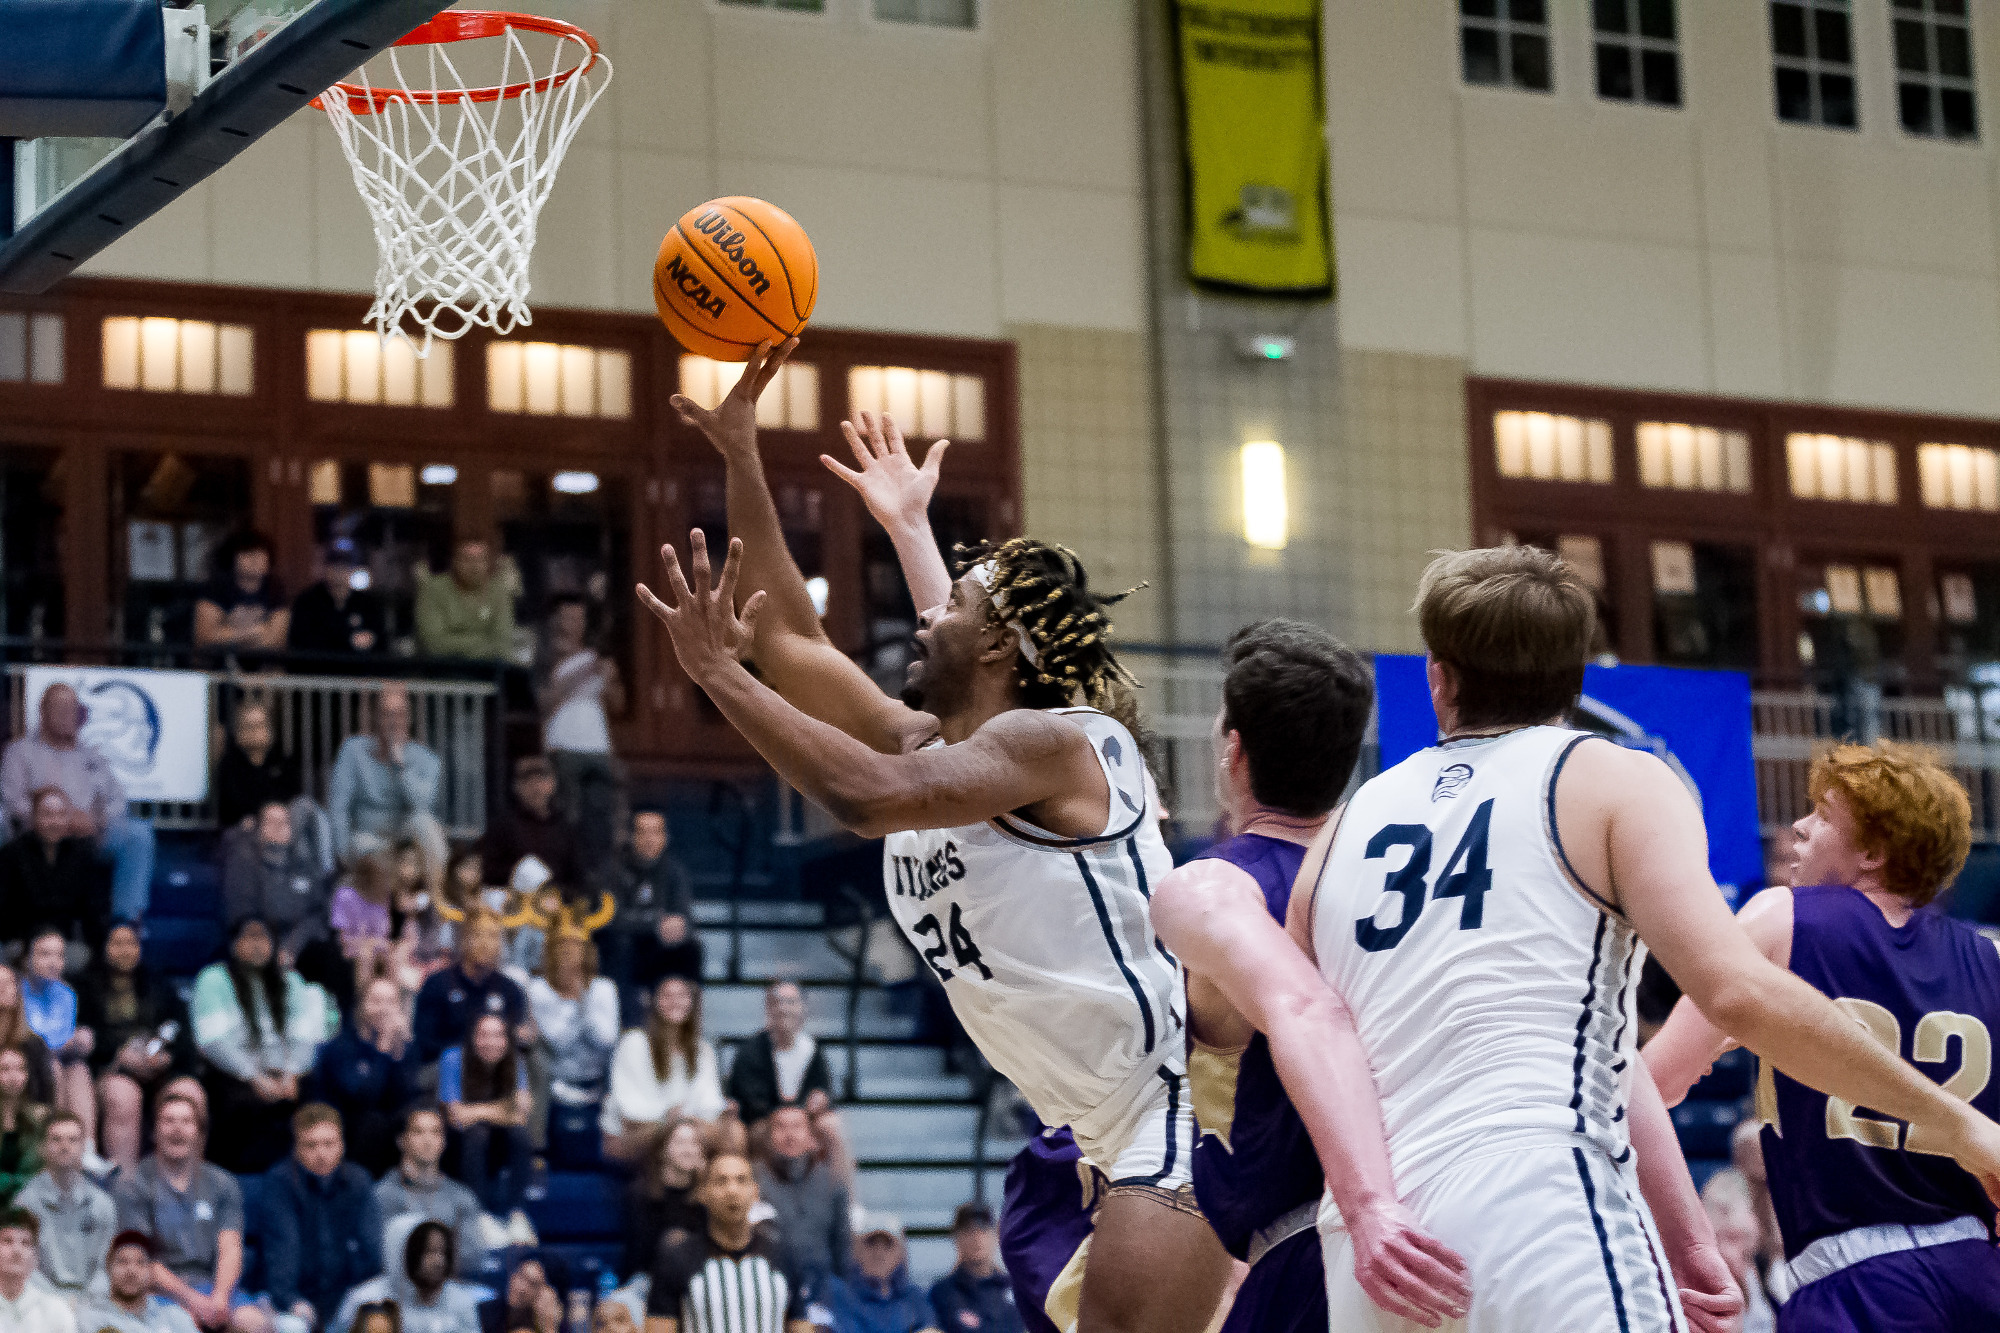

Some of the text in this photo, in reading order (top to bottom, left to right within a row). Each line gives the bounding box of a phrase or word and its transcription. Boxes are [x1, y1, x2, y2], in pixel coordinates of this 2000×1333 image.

[666, 254, 727, 319] NCAA
[693, 208, 771, 297] Wilson
[1355, 797, 1496, 953] 34
[912, 901, 994, 982] 24
[1826, 996, 1993, 1158] 22
